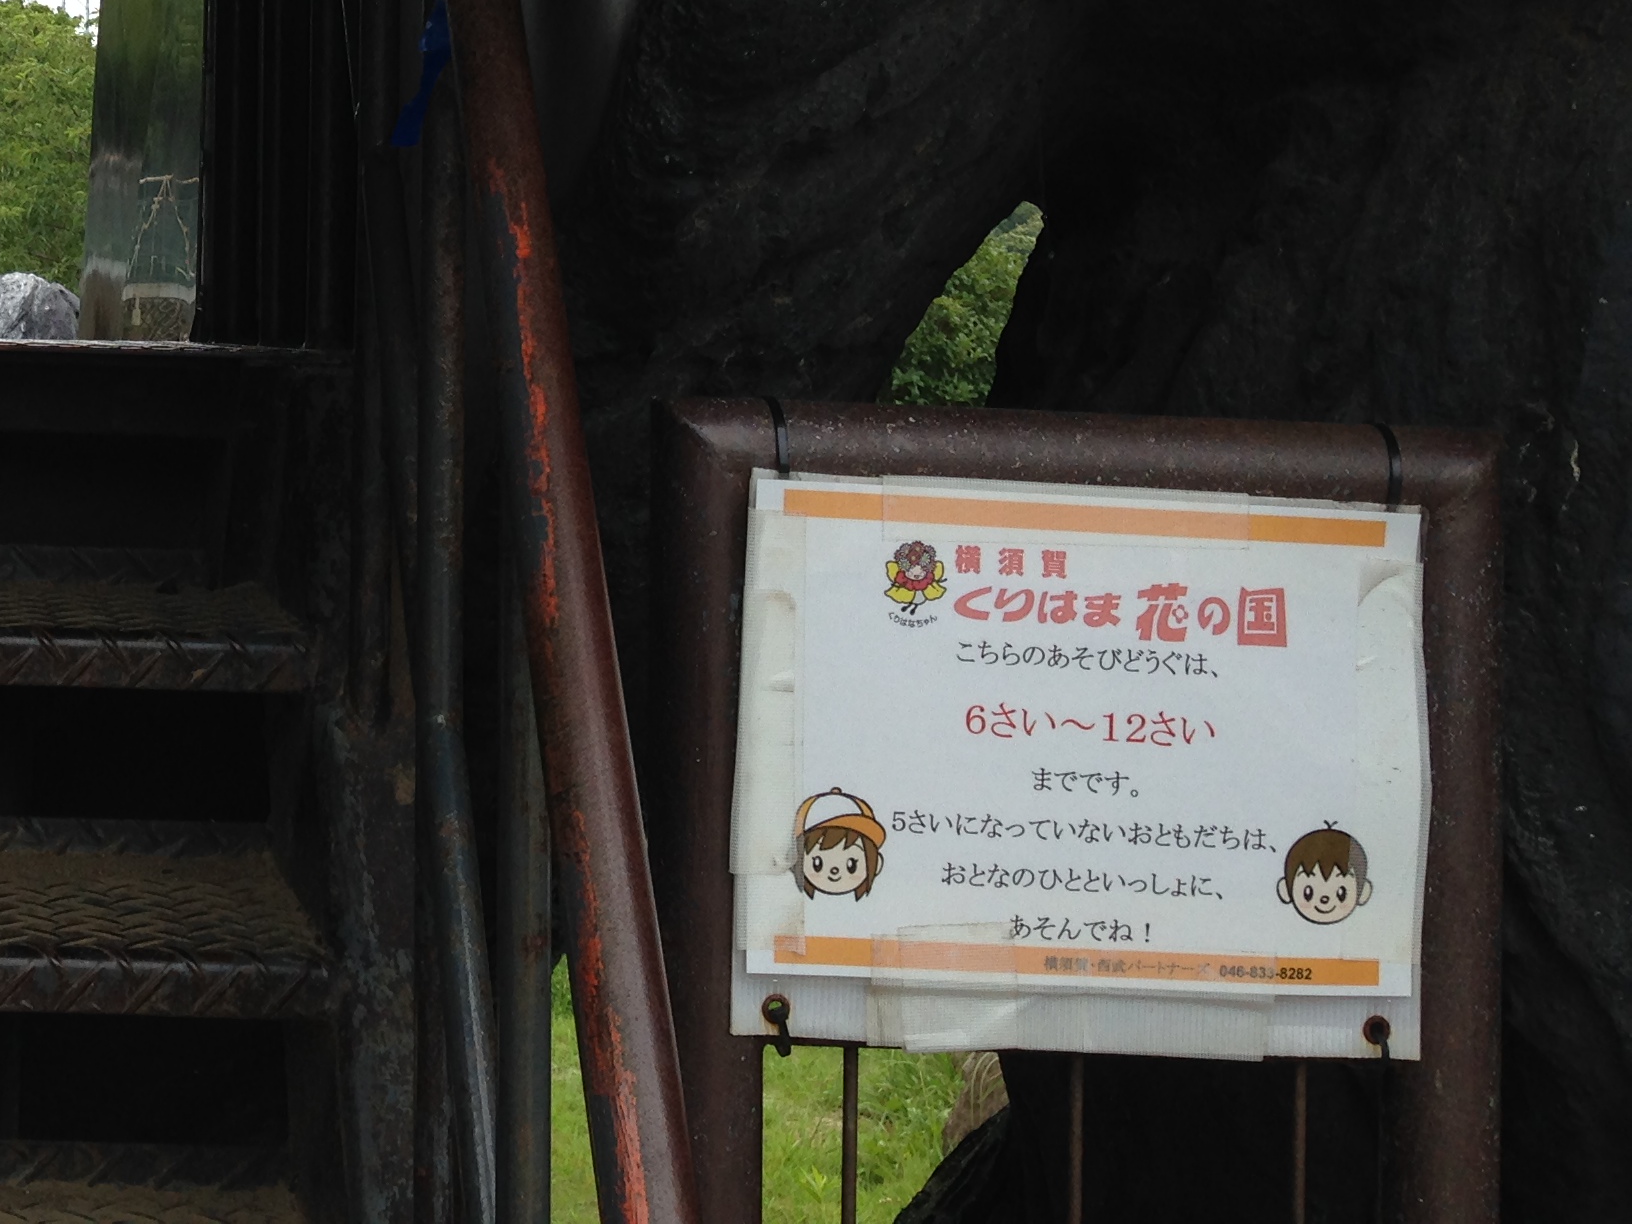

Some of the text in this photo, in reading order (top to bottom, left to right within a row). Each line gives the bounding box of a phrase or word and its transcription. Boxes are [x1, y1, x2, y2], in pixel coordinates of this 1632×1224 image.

[955, 544, 1068, 579] 横須賀
[953, 583, 1288, 648] くりはま花の国
[956, 640, 1219, 678] こちらのあそびどうぐは、
[1031, 768, 1140, 798] までです。
[892, 810, 1277, 854] 5さいになっていないおともだちは、
[941, 862, 1223, 901] おとなのひとといっしょに、
